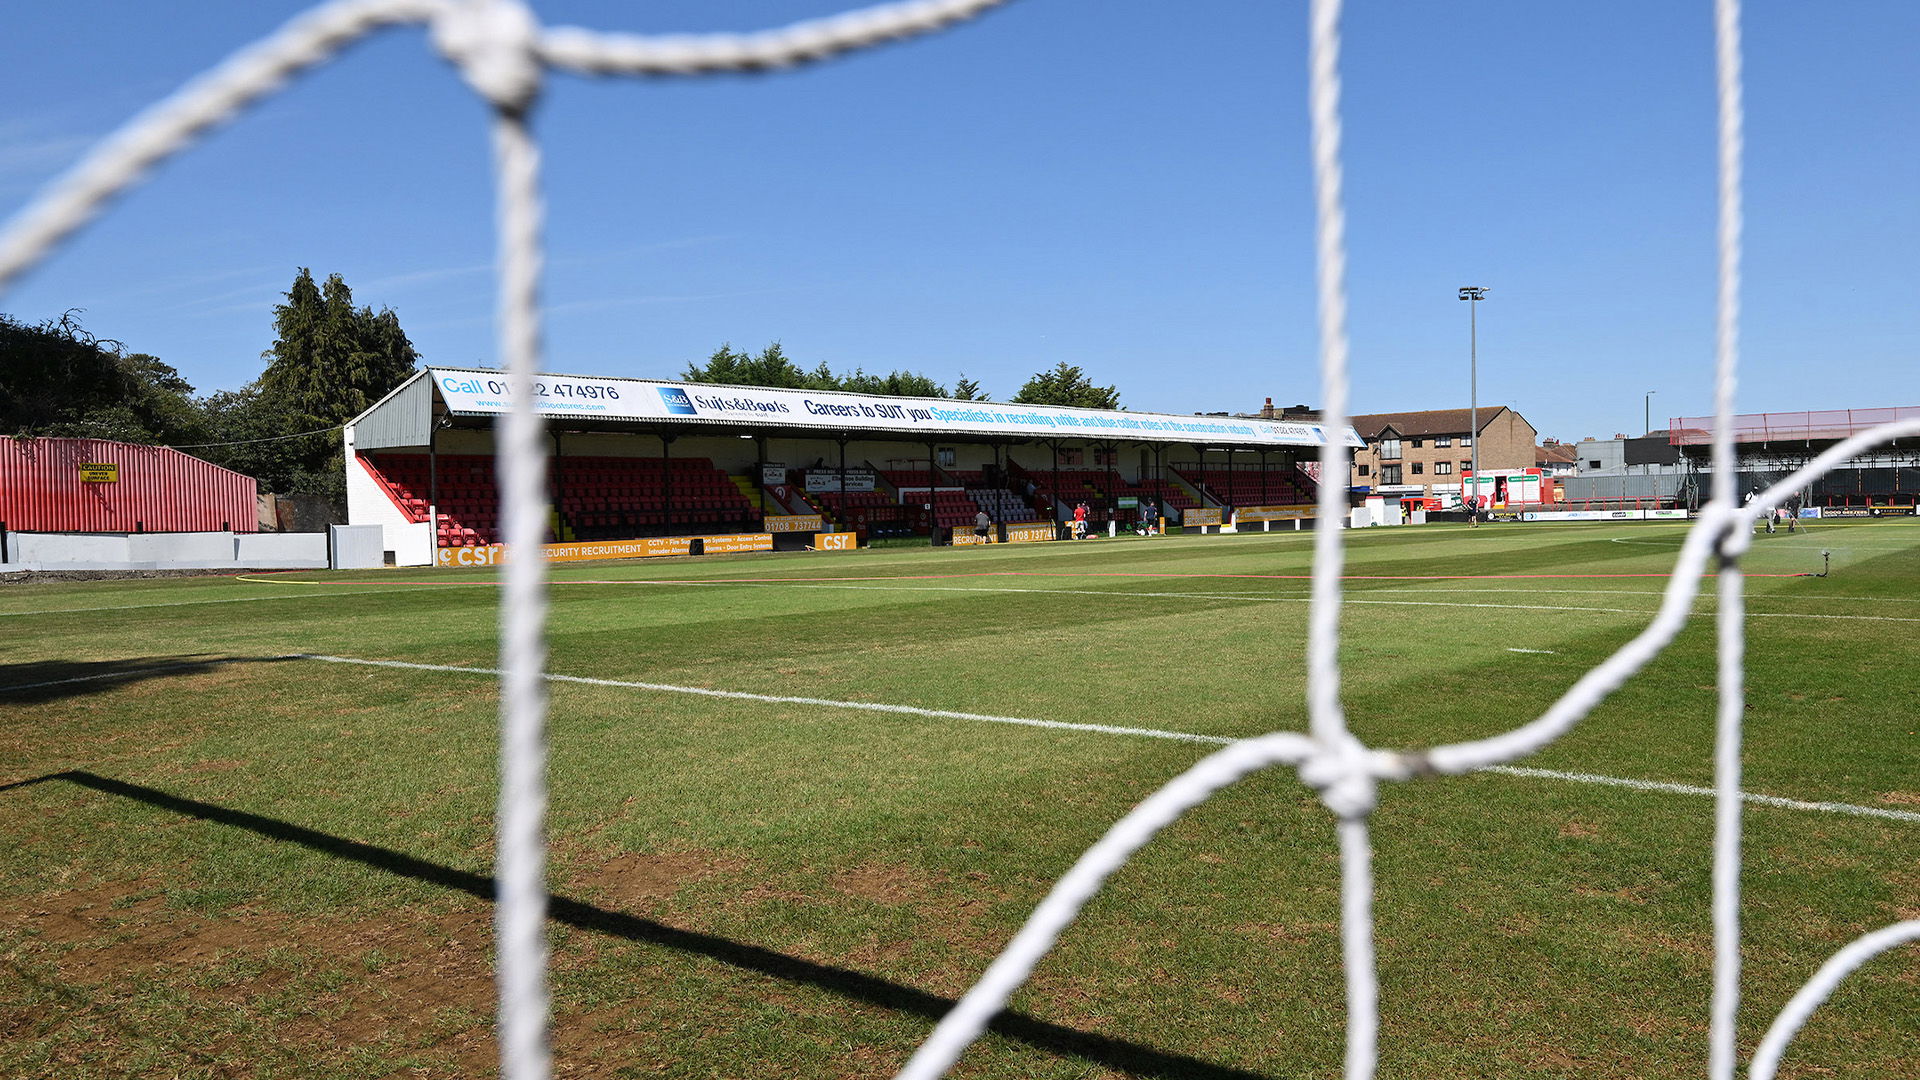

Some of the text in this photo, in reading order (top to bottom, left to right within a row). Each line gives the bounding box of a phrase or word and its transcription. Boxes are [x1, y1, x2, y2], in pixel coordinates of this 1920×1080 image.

[442, 378, 620, 400] Call 0122 474976
[664, 394, 689, 404] S&B
[694, 395, 790, 414] Suits&Boots
[804, 399, 1257, 437] Careers to SUIT you Specialists in recruiting white and blue collar roles in the construction industry
[765, 521, 822, 531] 01708 737744
[823, 535, 849, 549] csr
[457, 547, 498, 566] csr
[540, 547, 580, 558] ECURITY
[581, 545, 642, 556] RECRUITMENT
